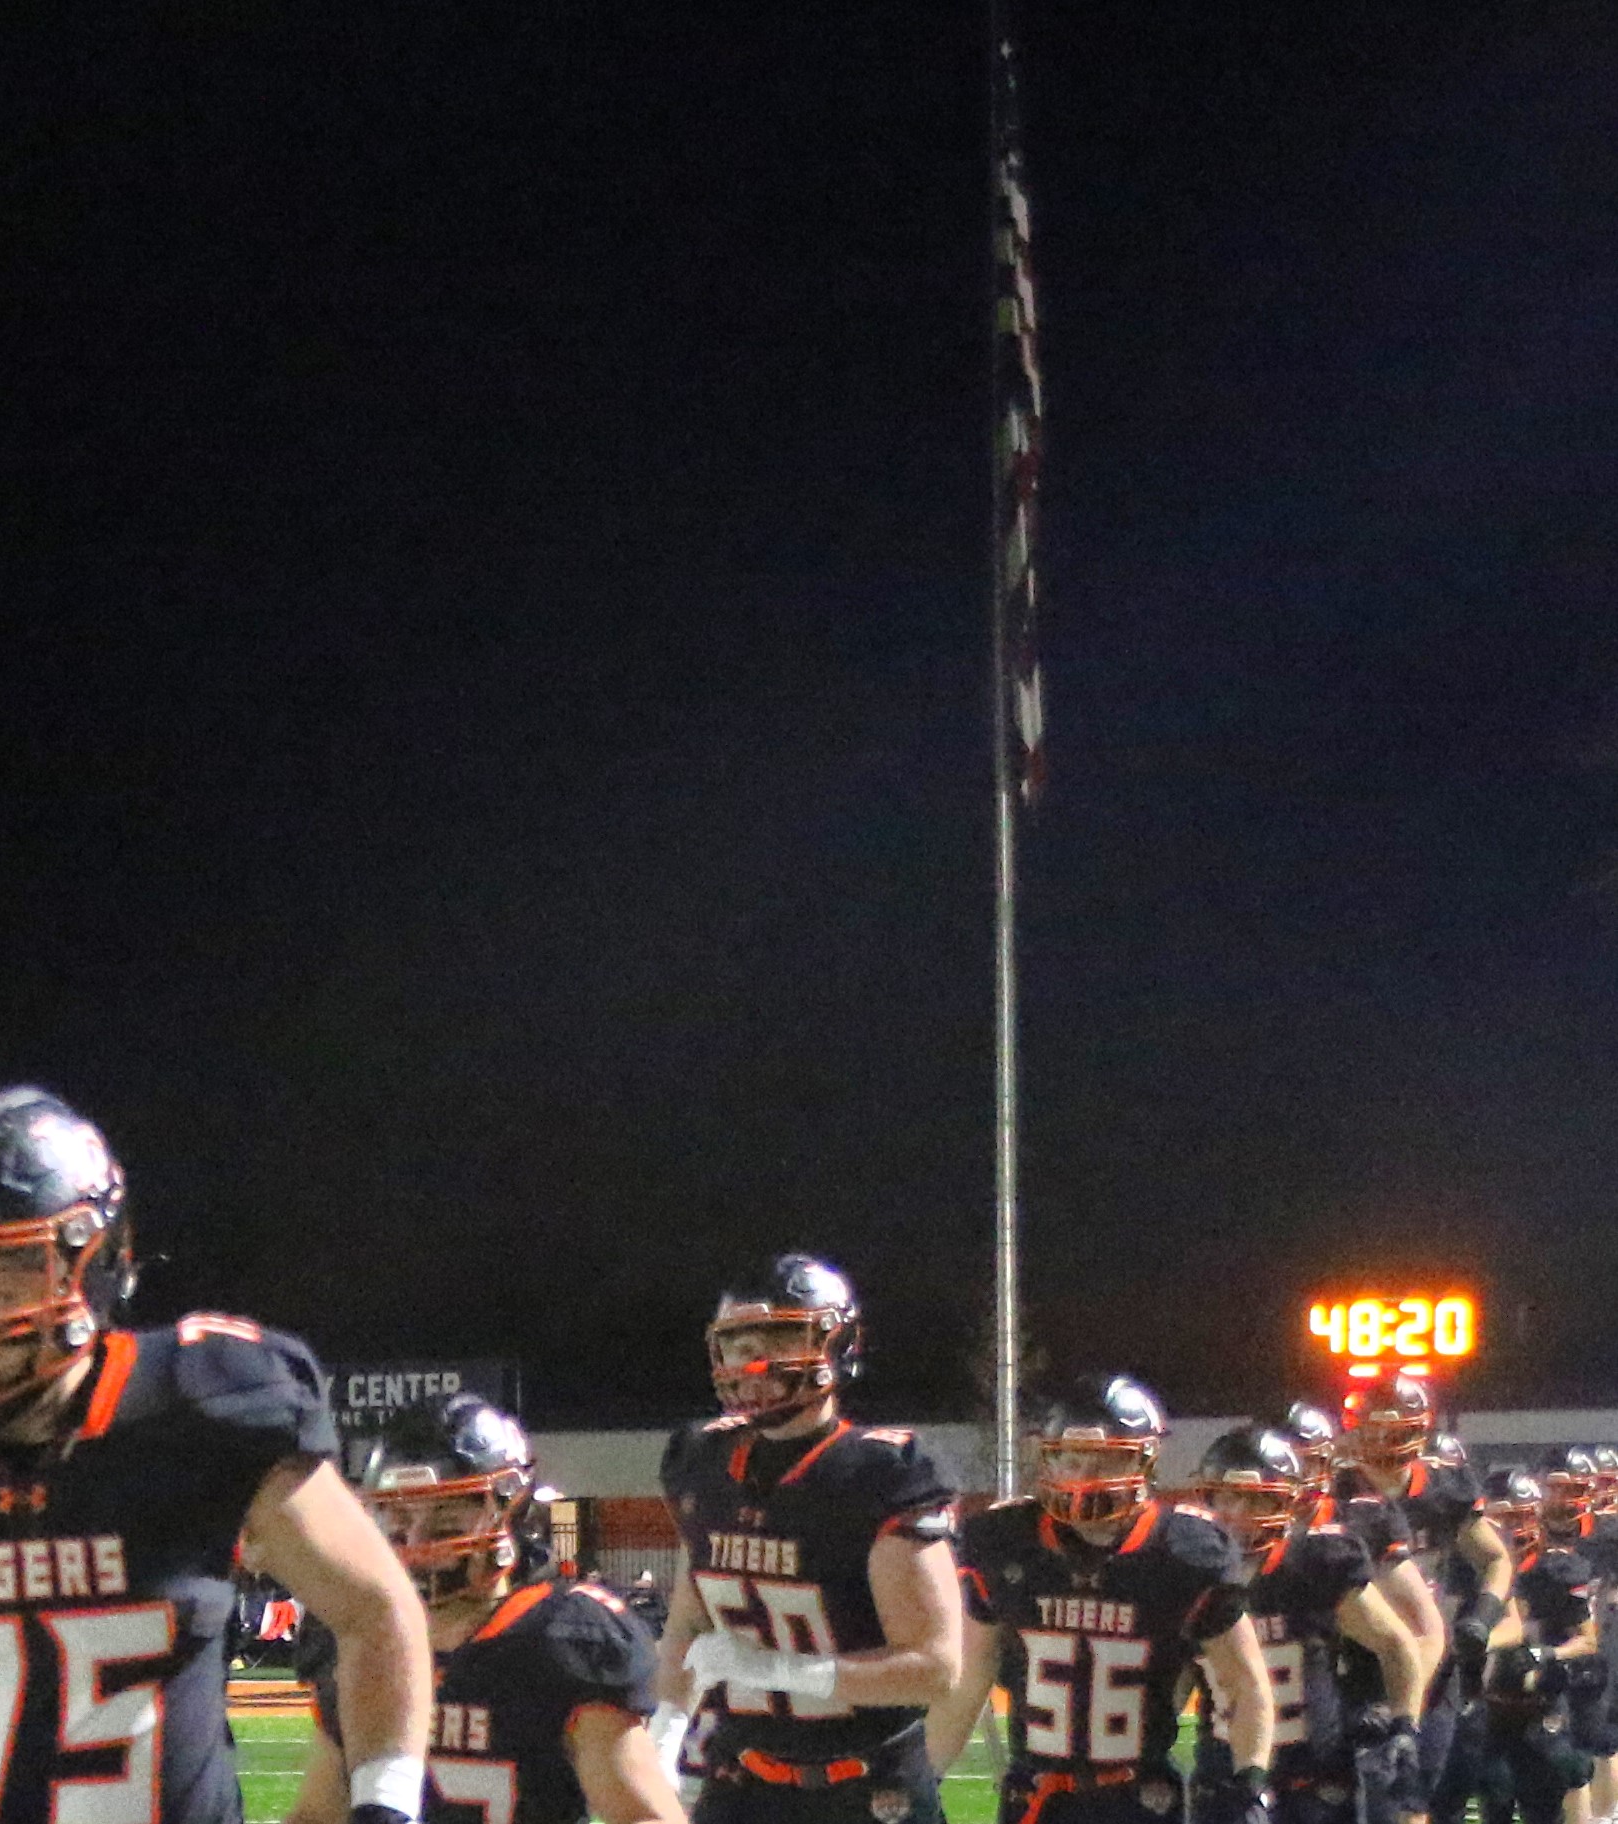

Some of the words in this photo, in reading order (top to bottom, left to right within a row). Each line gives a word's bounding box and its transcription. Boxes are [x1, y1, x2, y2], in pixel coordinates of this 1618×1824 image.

[1307, 1298, 1473, 1357] 48:20
[348, 1373, 461, 1407] CENTER
[708, 1530, 800, 1577] TIGERS
[1035, 1595, 1135, 1634] TIGERS
[1017, 1628, 1152, 1763] 56
